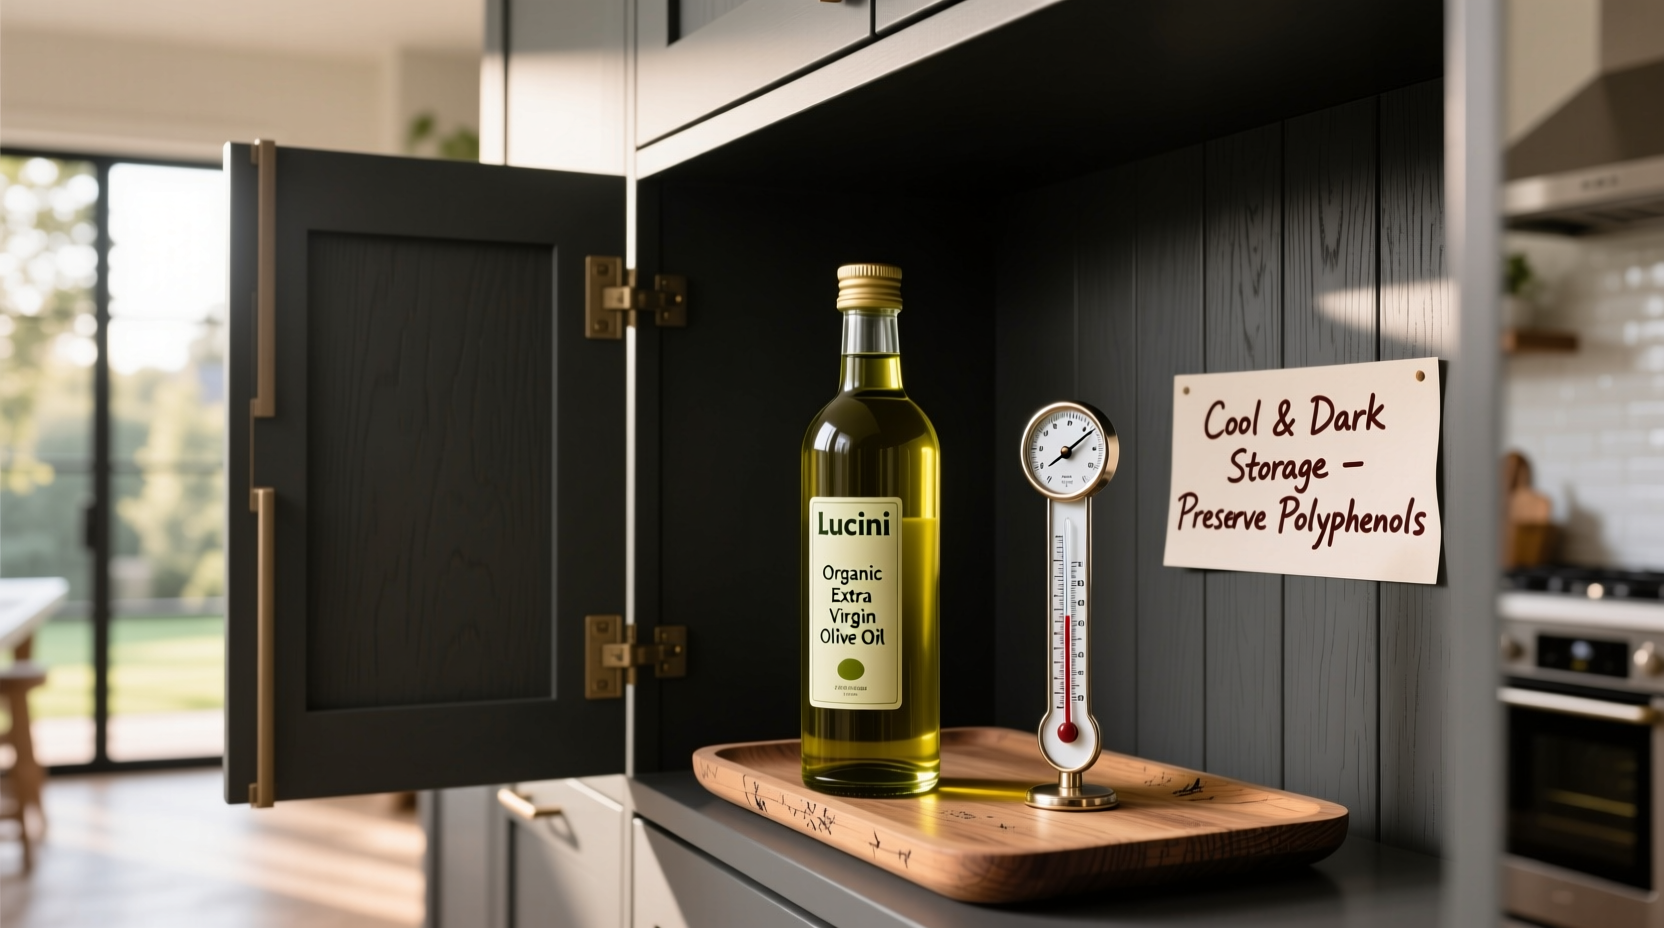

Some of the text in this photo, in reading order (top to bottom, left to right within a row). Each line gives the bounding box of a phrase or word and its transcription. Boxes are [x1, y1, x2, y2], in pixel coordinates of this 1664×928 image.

[1204, 392, 1386, 440] Cool & Dark
[1227, 447, 1329, 494] Storage
[818, 511, 890, 536] Lucini
[1177, 491, 1427, 550] Preserve Polyphenols
[823, 564, 883, 585] Organic
[831, 588, 872, 603] Extra
[829, 608, 876, 628] Virgin
[820, 628, 885, 645] Olive Oil
